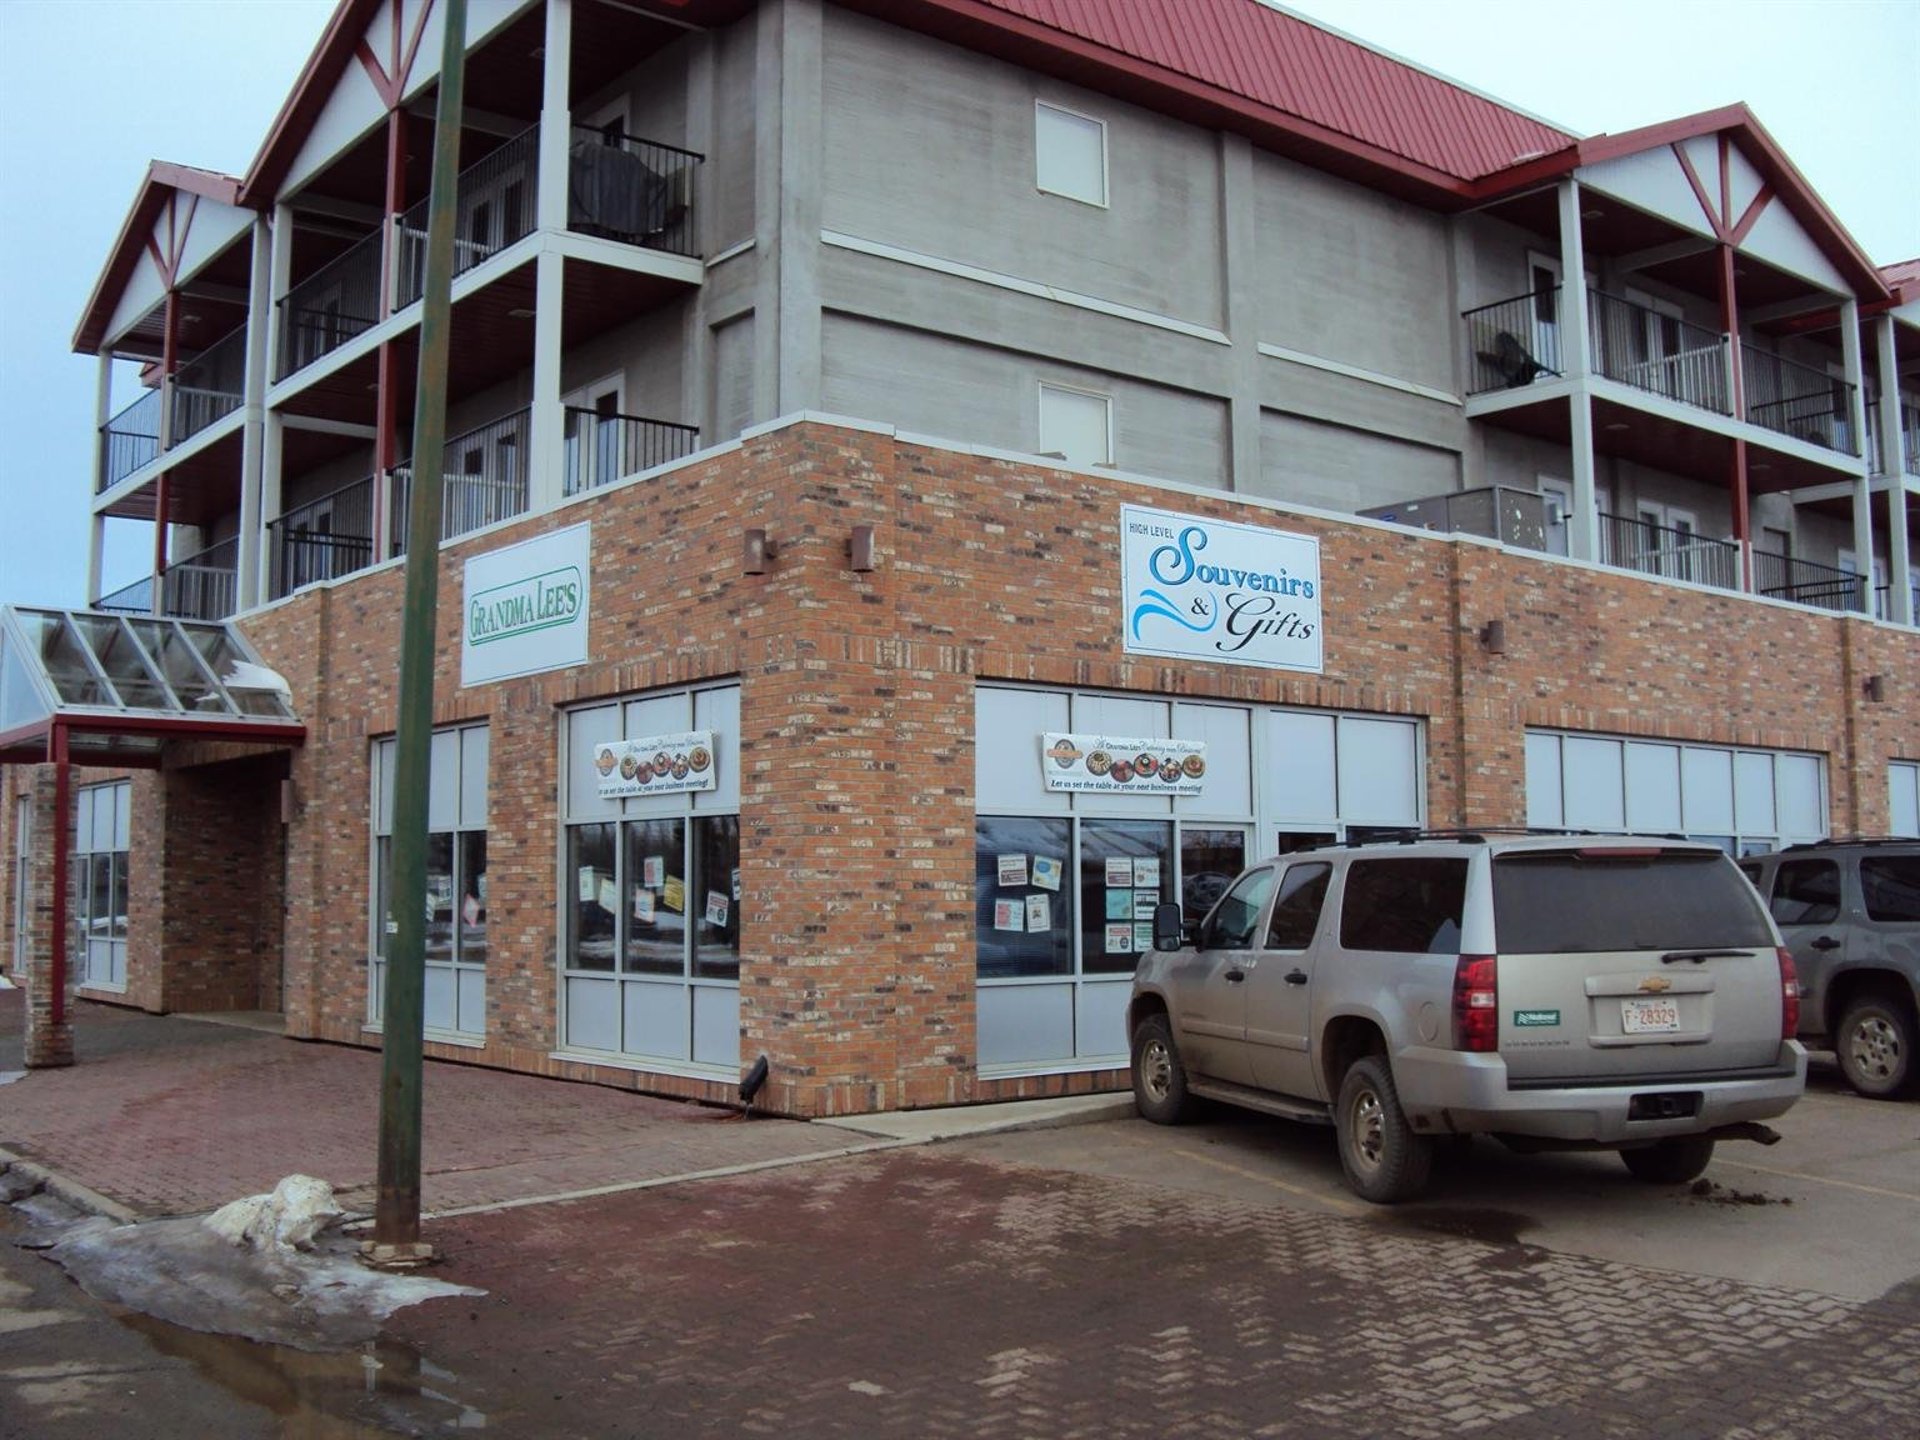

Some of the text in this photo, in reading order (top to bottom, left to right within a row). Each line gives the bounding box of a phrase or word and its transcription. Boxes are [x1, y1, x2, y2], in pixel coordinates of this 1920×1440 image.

[1129, 523, 1174, 539] HIGH LEVEL
[1149, 526, 1314, 599] Souvenirs
[470, 581, 577, 638] GRANDMA LEE'S
[1190, 592, 1315, 652] & Gifts
[1050, 779, 1063, 788] Let
[1072, 780, 1083, 789] set
[1083, 780, 1095, 789] the
[1095, 780, 1113, 790] table
[1120, 783, 1135, 791] your
[1150, 782, 1177, 792] business
